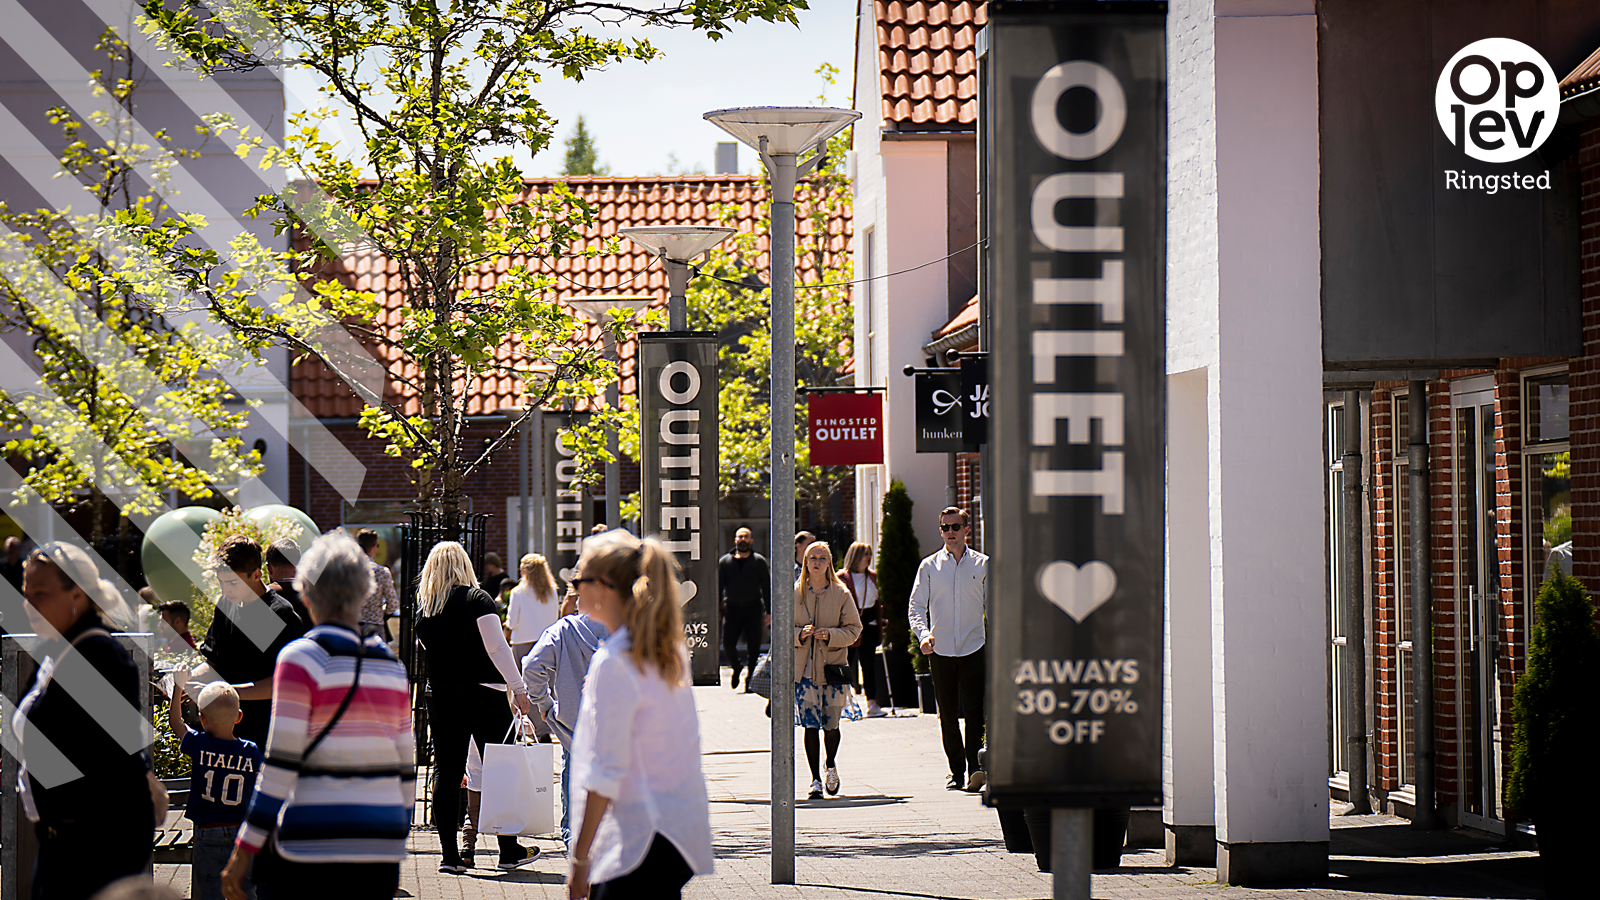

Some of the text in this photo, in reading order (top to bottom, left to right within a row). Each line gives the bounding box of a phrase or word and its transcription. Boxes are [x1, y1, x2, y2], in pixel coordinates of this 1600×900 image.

[1030, 60, 1126, 515] OUTLET
[969, 384, 990, 401] JA
[815, 417, 877, 426] RINGSTED
[815, 427, 877, 441] OUTLET
[659, 360, 701, 560] OUTLET
[683, 623, 709, 635] AYS
[1015, 659, 1140, 685] ALWAYS
[1016, 688, 1139, 715] 30-70%
[1049, 719, 1105, 745] OFF
[200, 750, 254, 773] ITALIA
[201, 769, 245, 806] 10
